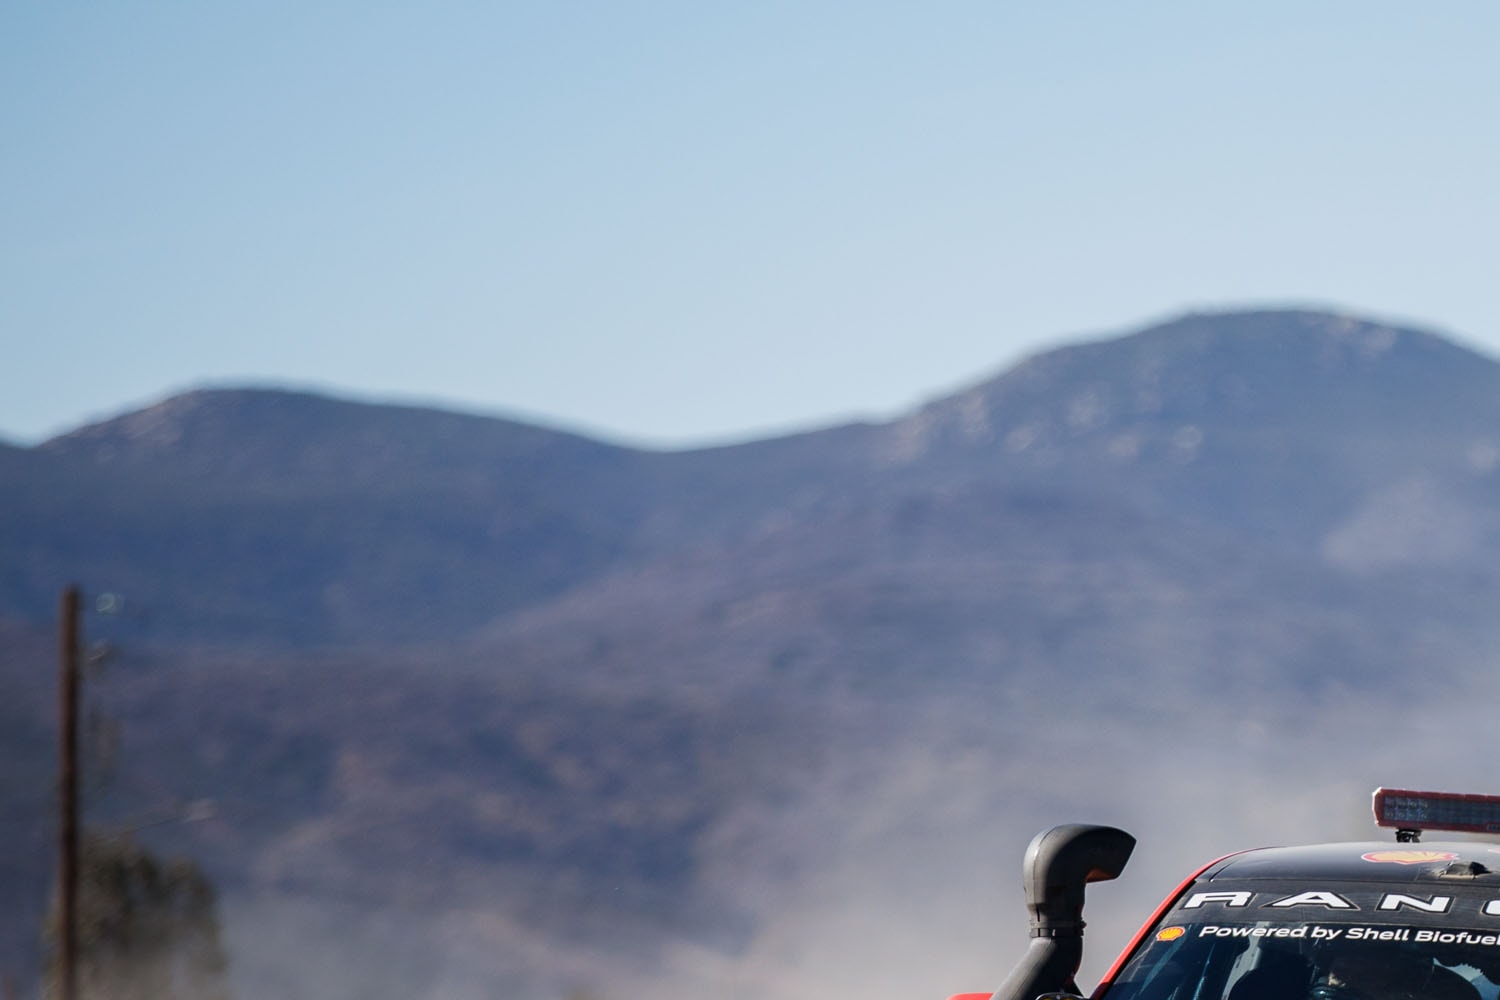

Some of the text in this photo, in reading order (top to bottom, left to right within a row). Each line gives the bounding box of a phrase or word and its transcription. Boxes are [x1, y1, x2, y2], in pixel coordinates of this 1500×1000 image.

[1199, 925, 1308, 939] Powered
[1311, 926, 1342, 940] by
[1345, 927, 1409, 941] Shell
